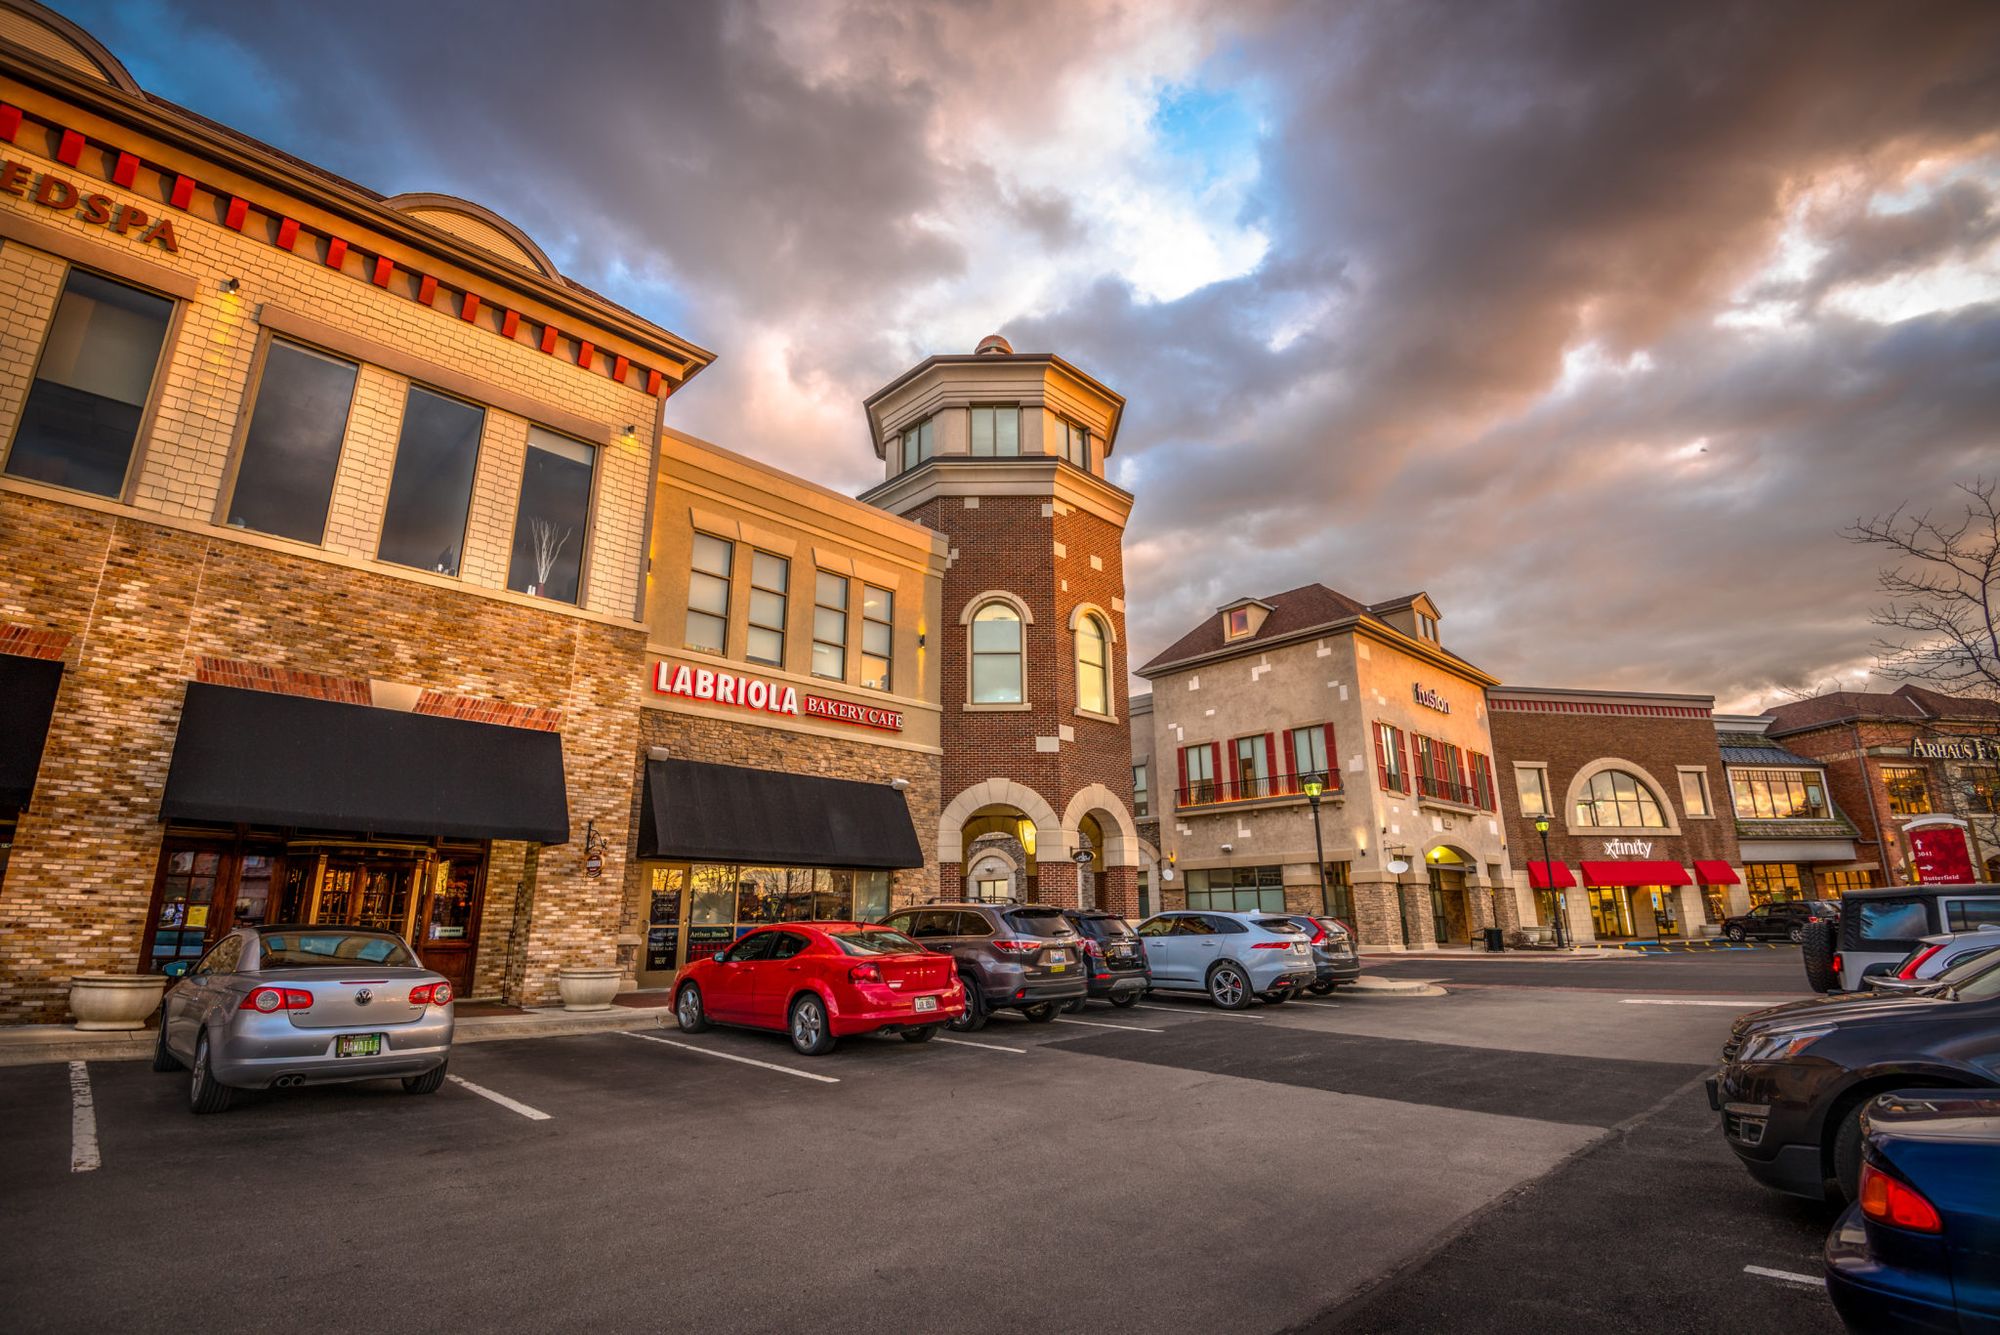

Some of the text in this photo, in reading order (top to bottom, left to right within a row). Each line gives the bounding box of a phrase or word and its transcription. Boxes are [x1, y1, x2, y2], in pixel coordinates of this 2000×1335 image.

[0, 160, 179, 253] EDSPA
[657, 661, 799, 715] LABRIOLA
[1412, 682, 1452, 714] fusion
[807, 697, 903, 728] BAKERY CAFE
[1911, 736, 1973, 759] ARHAUS
[1603, 838, 1652, 859] xfinity
